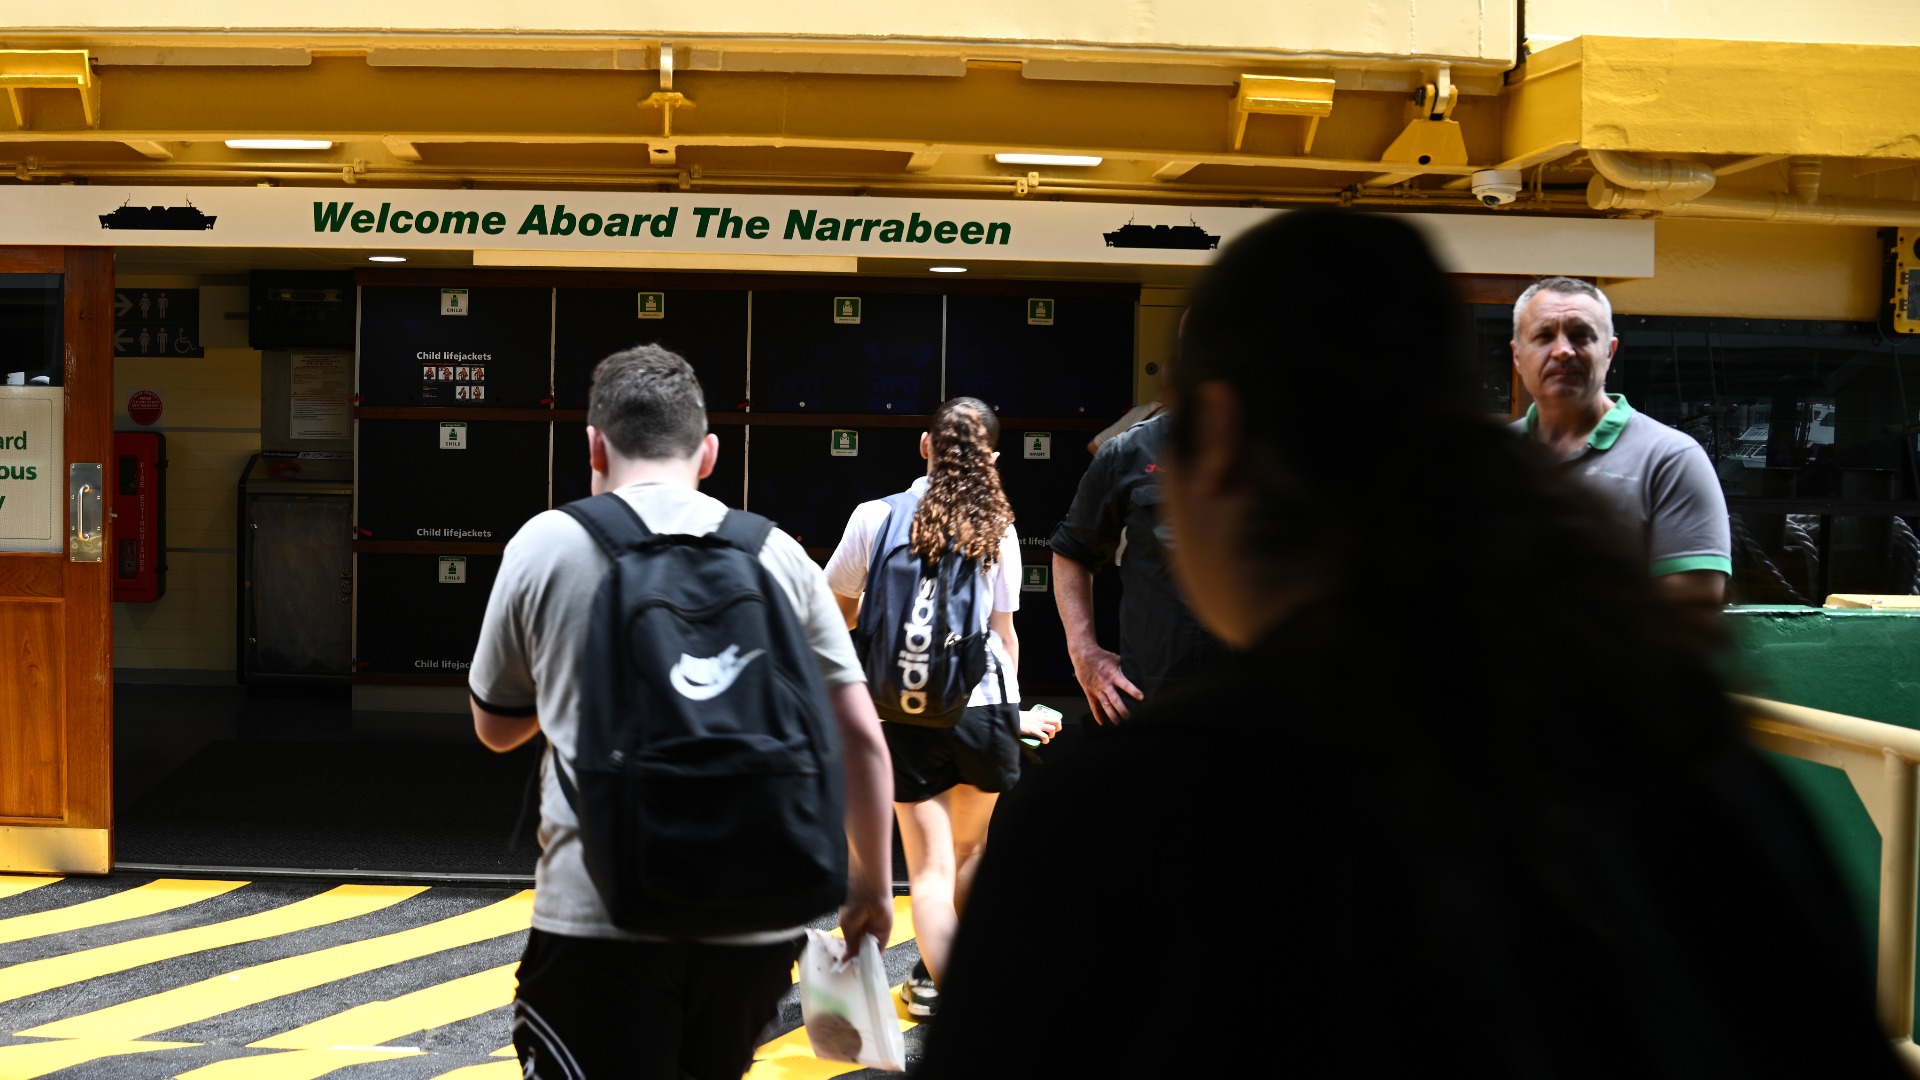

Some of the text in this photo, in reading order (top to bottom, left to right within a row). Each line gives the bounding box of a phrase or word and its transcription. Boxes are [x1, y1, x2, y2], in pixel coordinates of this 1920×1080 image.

[313, 201, 1012, 245] Welcome Aboard The Narrabeen
[416, 351, 492, 362] Child lifejackets
[0, 465, 37, 481] ous
[416, 528, 492, 539] Child lifejackets
[897, 576, 938, 716] adidas
[414, 659, 439, 669] Child
